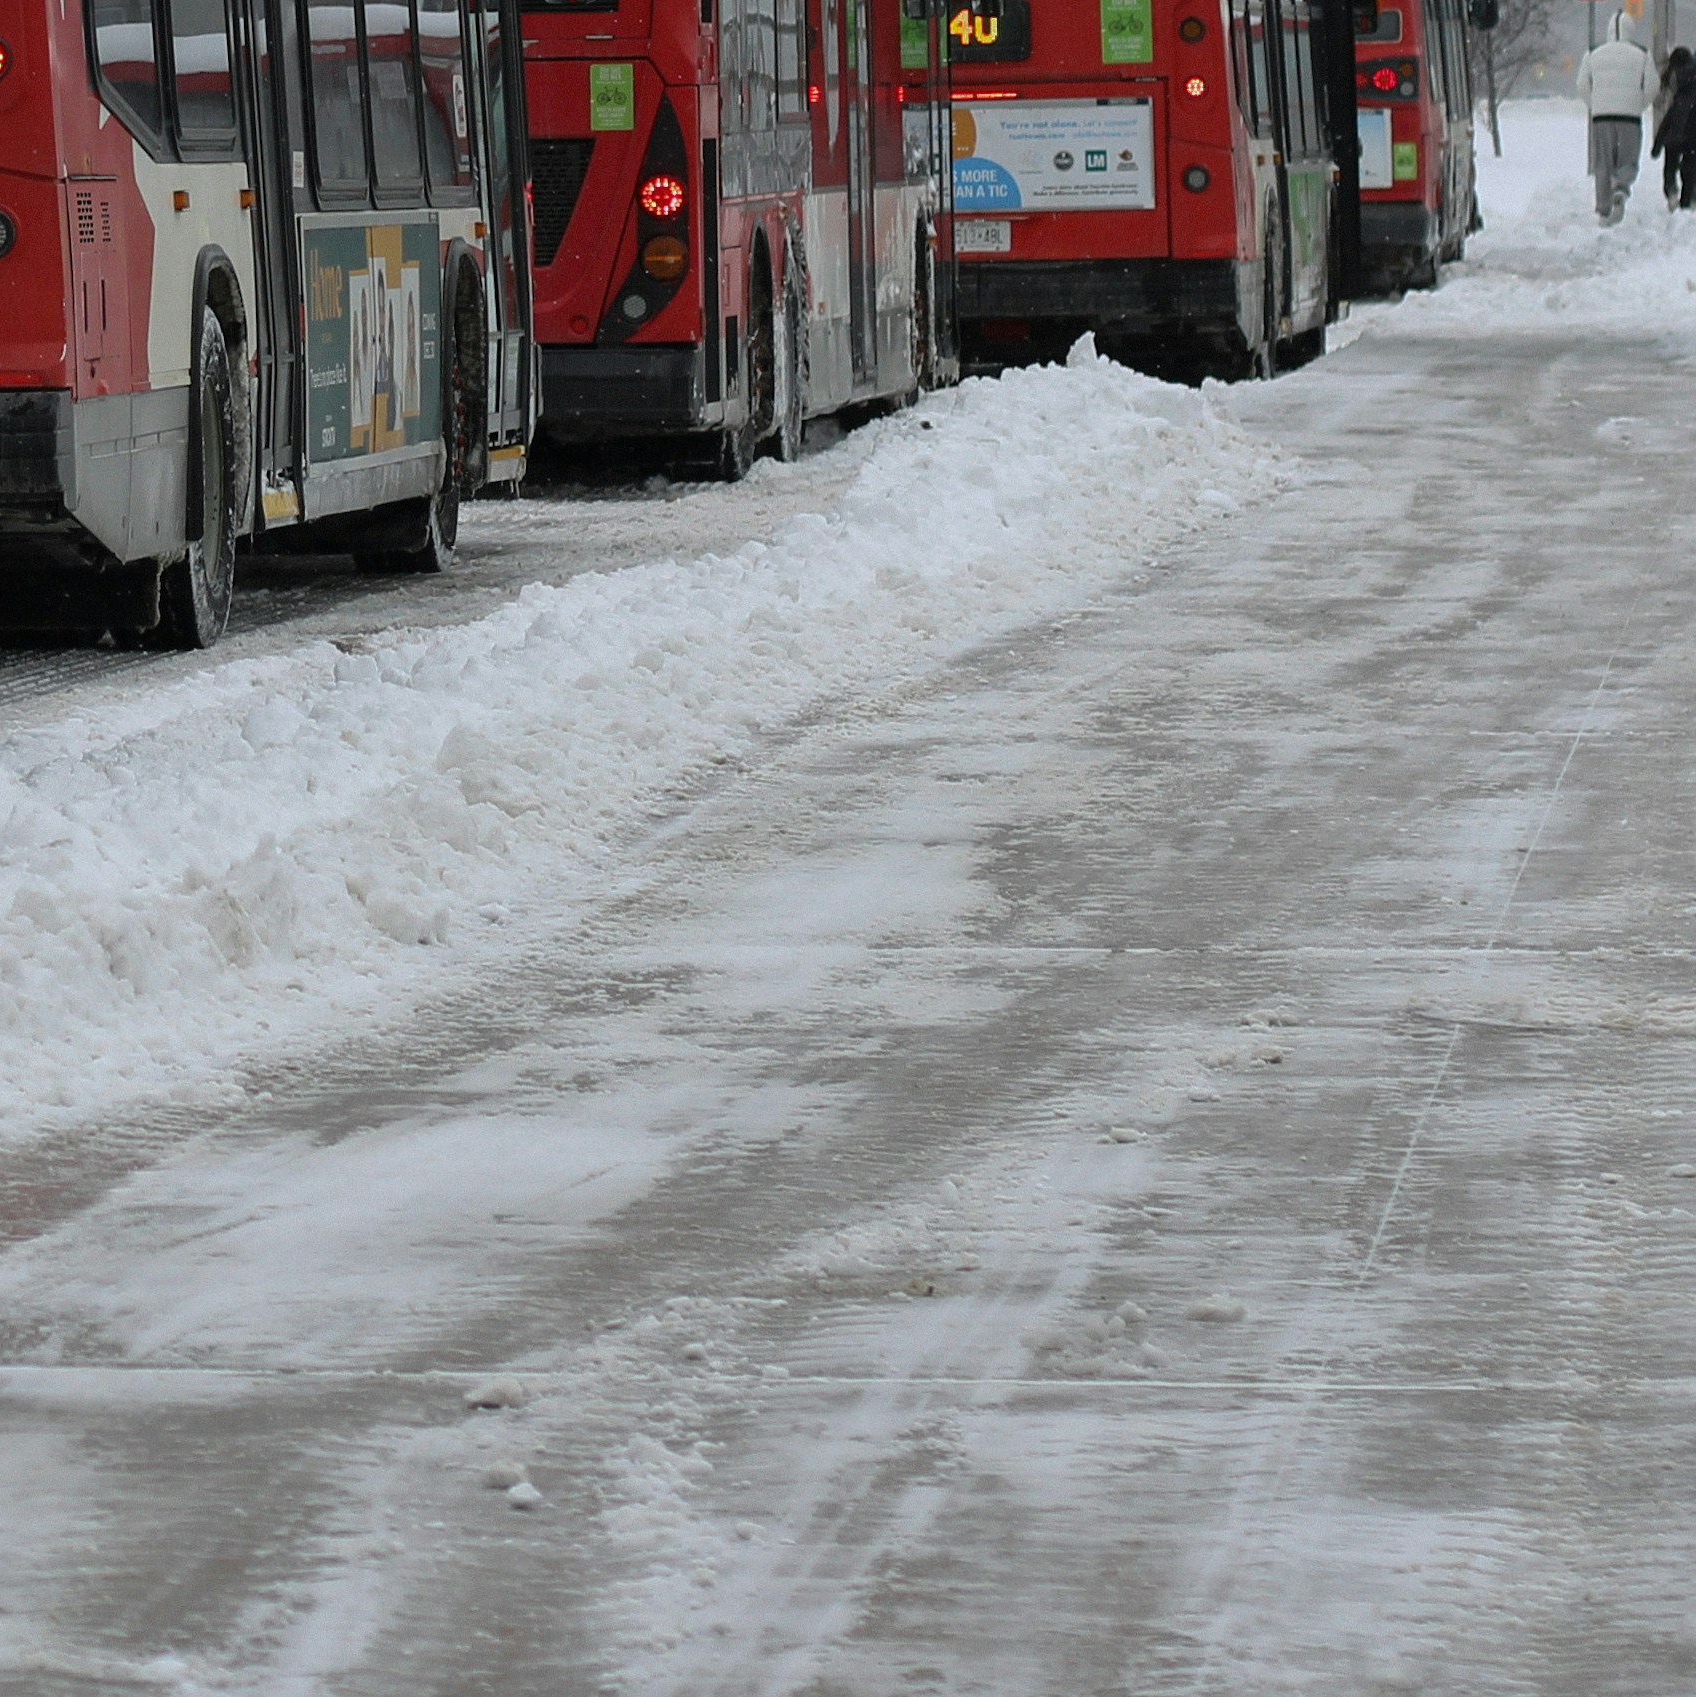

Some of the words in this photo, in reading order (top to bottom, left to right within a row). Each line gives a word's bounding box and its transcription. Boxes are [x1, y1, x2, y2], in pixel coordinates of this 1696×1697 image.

[1087, 154, 1105, 168] LM
[961, 169, 997, 182] MORE
[976, 185, 985, 197] A
[989, 184, 1008, 197] TIC
[310, 248, 343, 321] Home
